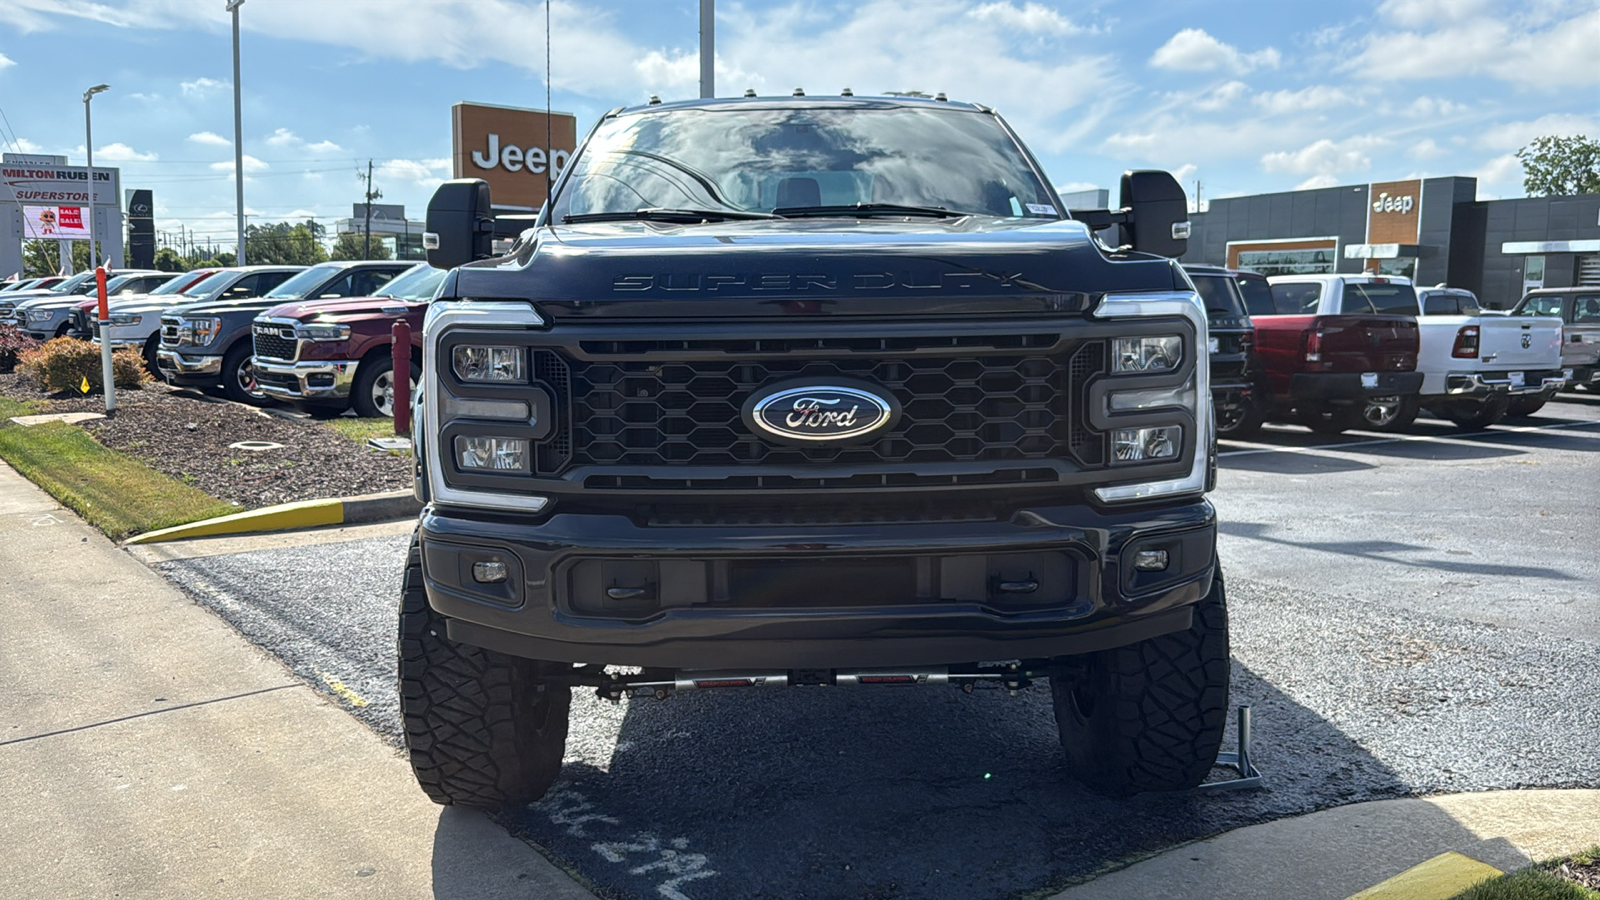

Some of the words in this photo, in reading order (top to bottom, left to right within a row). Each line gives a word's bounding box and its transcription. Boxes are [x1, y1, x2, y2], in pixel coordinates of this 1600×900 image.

[472, 133, 570, 181] Jeep
[2, 169, 55, 179] MILTON
[56, 171, 110, 181] RUBEN
[1372, 192, 1413, 214] Jeep
[613, 274, 837, 291] SUPER
[853, 272, 1022, 289] DUTY
[256, 326, 278, 336] RAM
[786, 397, 858, 427] Ford
